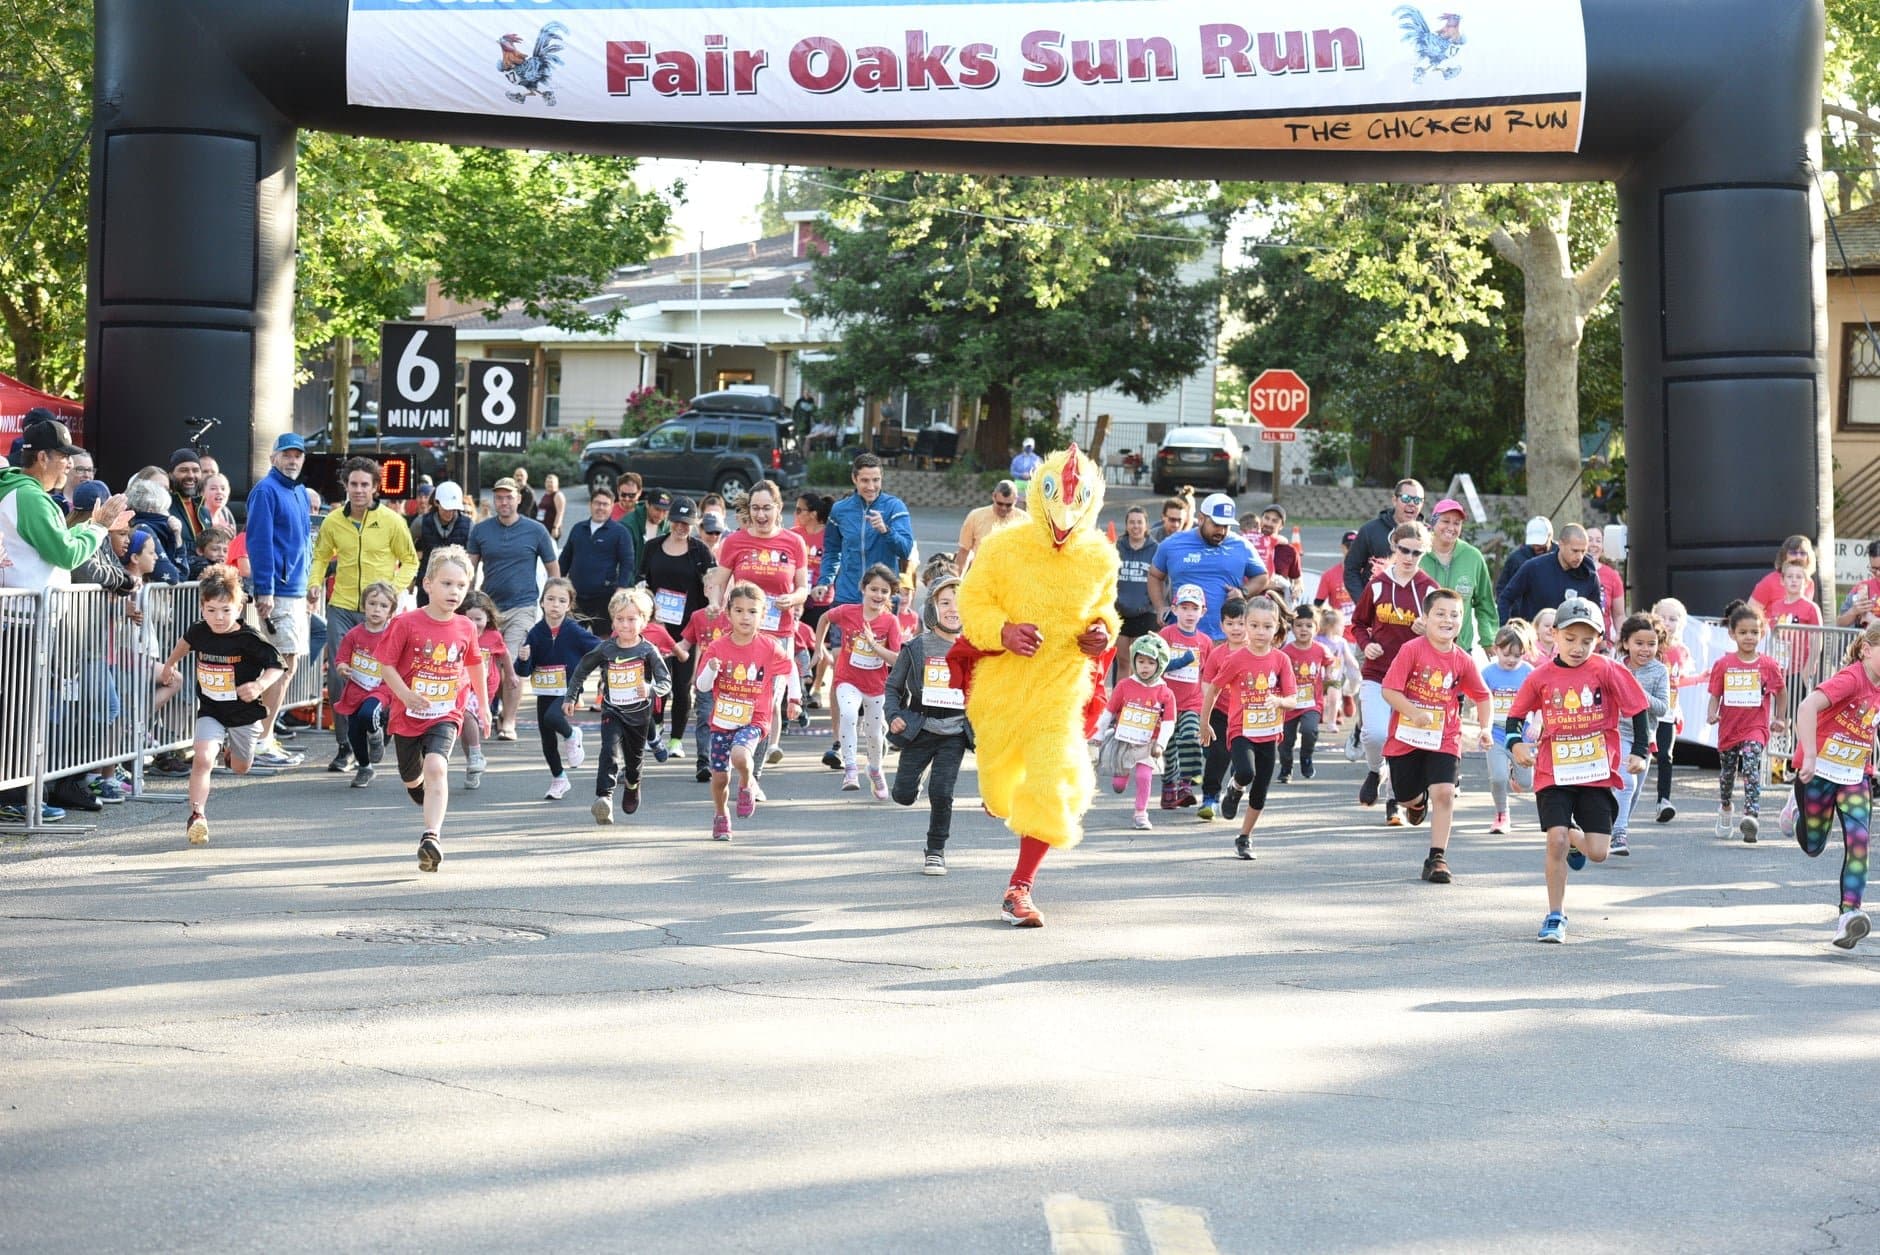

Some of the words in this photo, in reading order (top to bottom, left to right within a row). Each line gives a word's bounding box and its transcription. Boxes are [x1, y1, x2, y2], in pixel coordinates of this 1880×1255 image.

[606, 34, 768, 97] Fair
[788, 29, 1000, 93] Oaks
[1020, 29, 1179, 85] Sun
[1199, 22, 1366, 79] Run
[1285, 121, 1351, 143] THE
[1368, 113, 1492, 140] CHICKEN
[1504, 109, 1568, 133] RUN
[396, 329, 440, 403] 6
[481, 366, 517, 425] 8
[1252, 388, 1305, 412] STOP
[387, 408, 450, 431] MIN/MI
[470, 429, 522, 449] MIN/MI
[1263, 432, 1275, 440] ALL
[1280, 432, 1294, 440] WAY
[1834, 543, 1847, 557] IR
[353, 656, 378, 673] 994
[199, 672, 225, 686] 992
[927, 668, 951, 682] 96
[414, 681, 450, 696] 960
[1247, 711, 1277, 724] 923
[1557, 715, 1577, 724] Oaks
[1577, 713, 1591, 722] Sun
[1555, 741, 1595, 759] 938
[1826, 742, 1862, 761] 947
